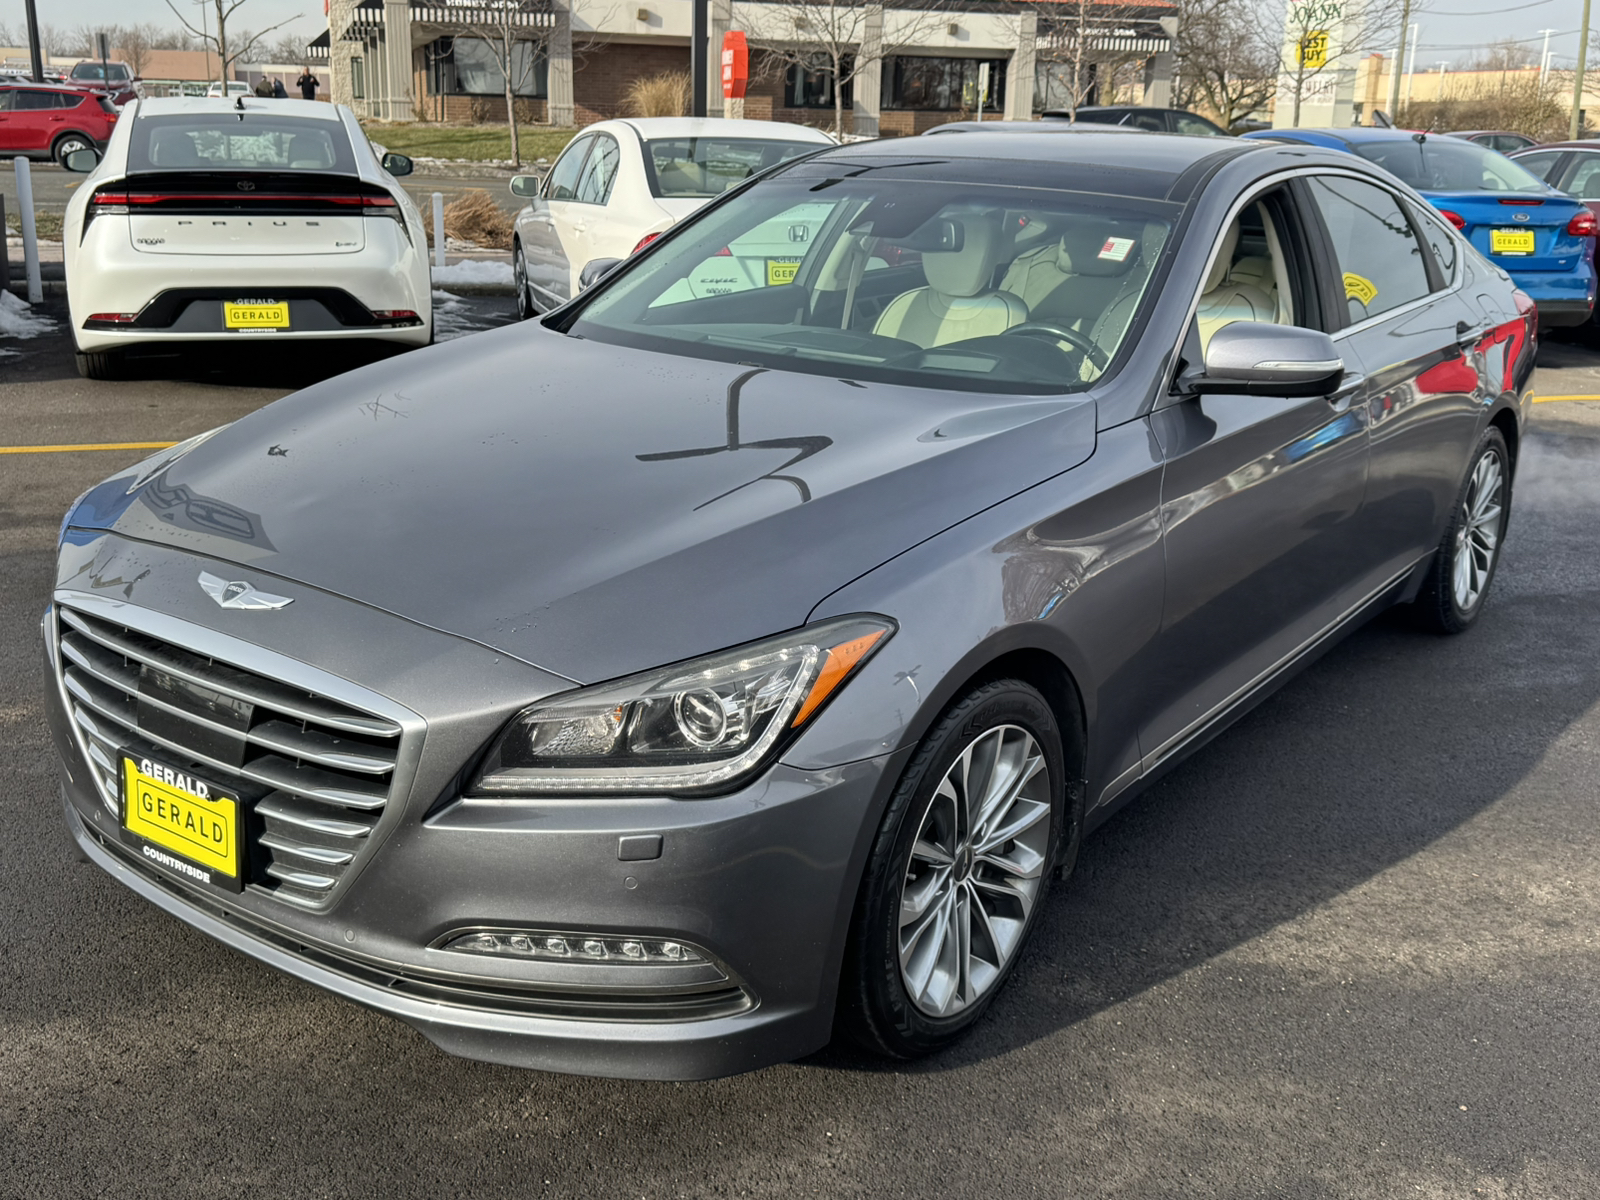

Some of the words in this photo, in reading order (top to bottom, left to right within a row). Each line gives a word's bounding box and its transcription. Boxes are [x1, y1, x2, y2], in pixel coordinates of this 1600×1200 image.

[1303, 37, 1327, 49] EST
[774, 270, 794, 278] GER
[233, 311, 280, 320] GERALD
[141, 758, 208, 798] GERALD
[142, 792, 222, 843] GERALD
[143, 845, 211, 883] COUNTRYSIDE
